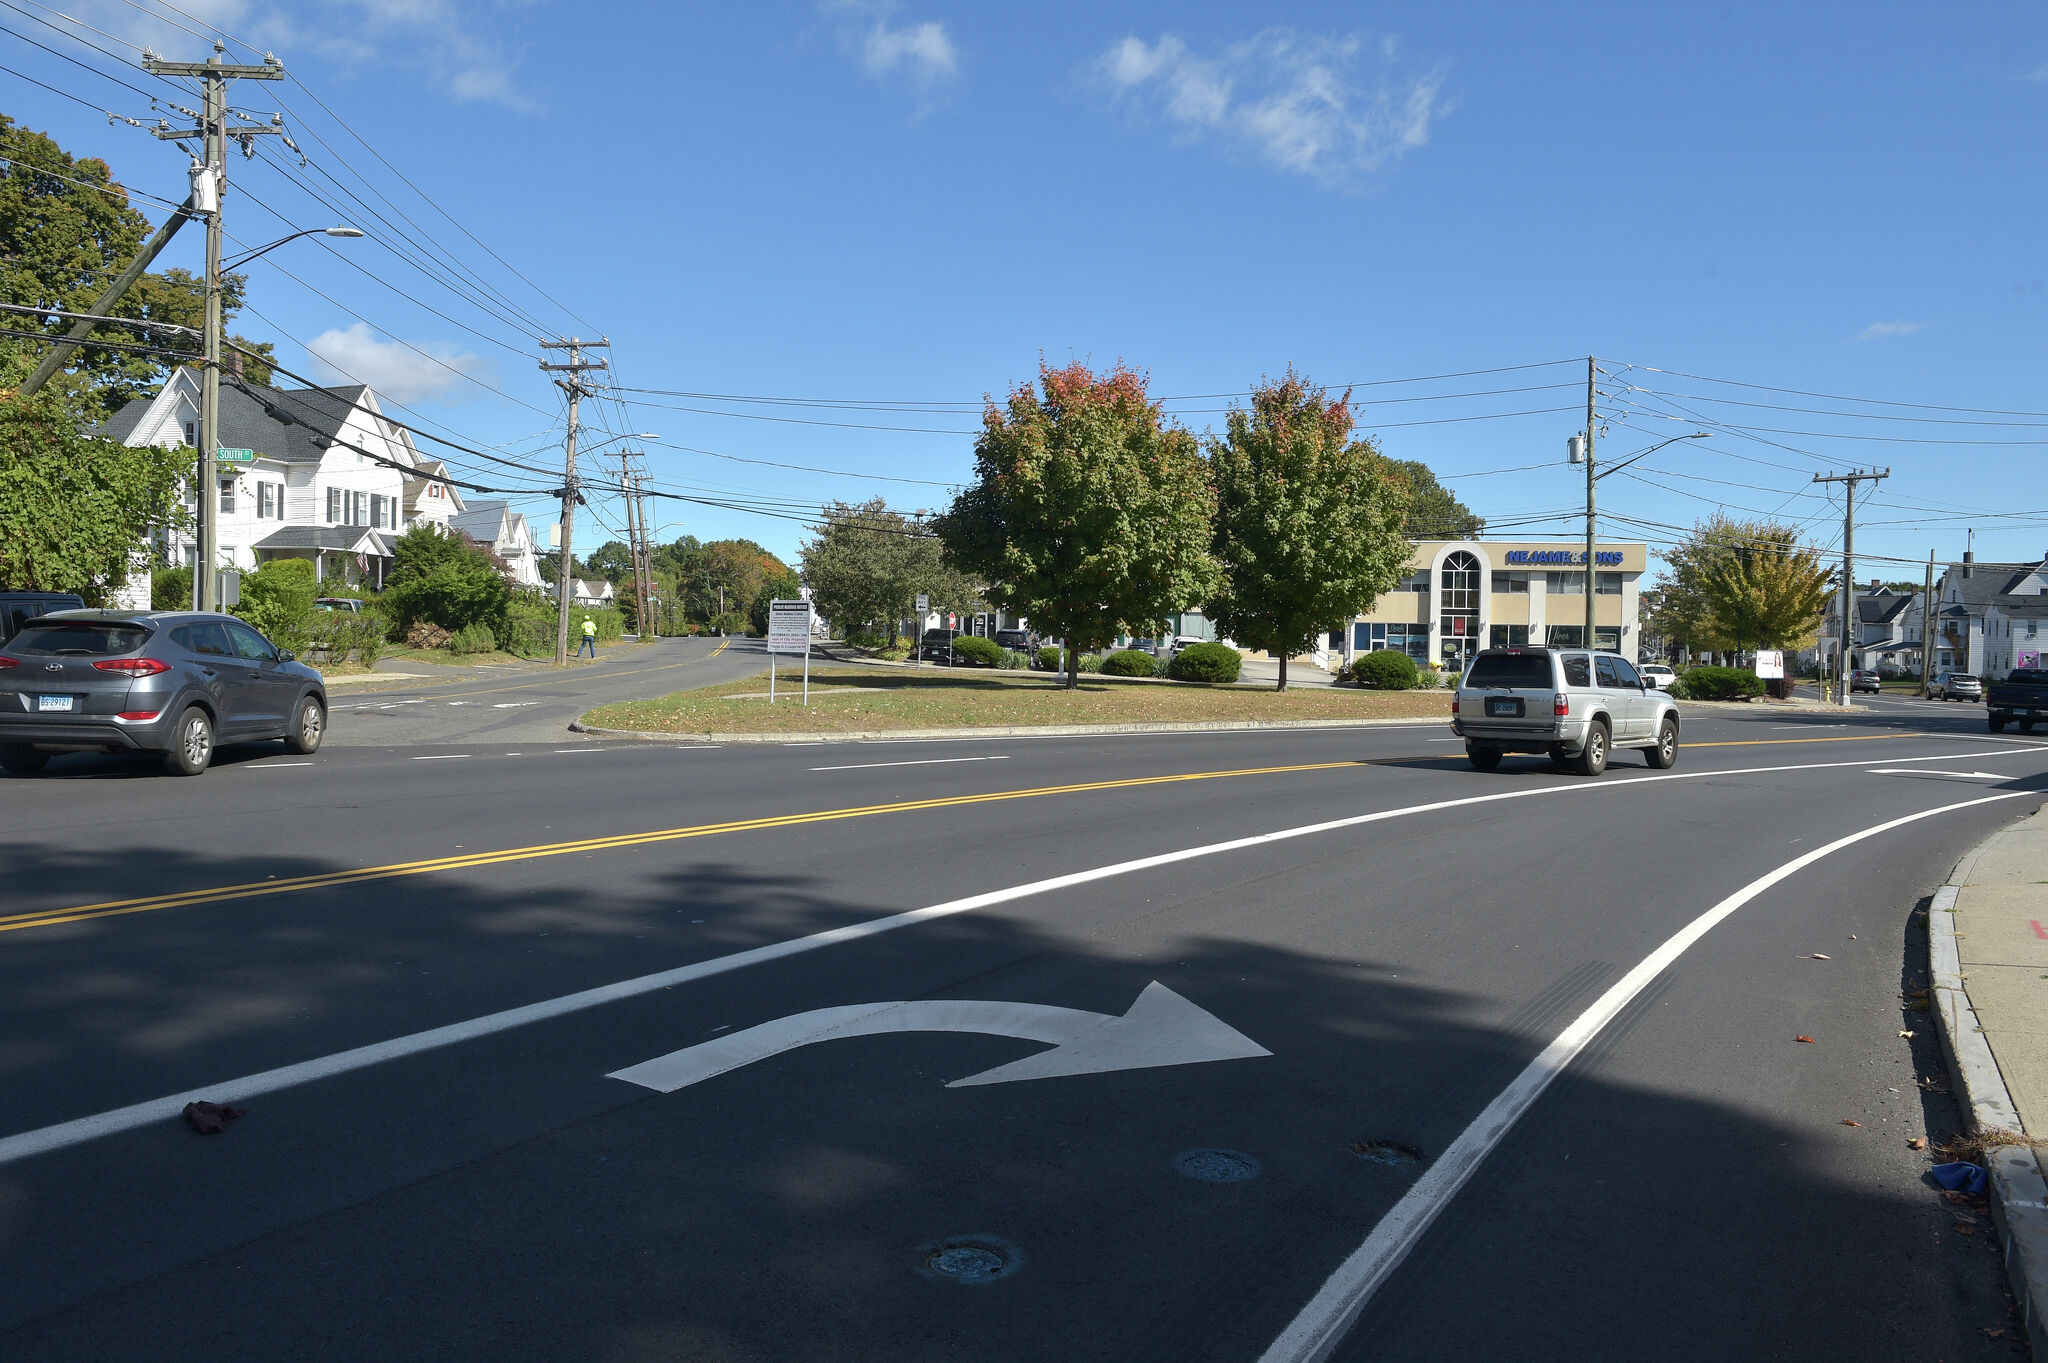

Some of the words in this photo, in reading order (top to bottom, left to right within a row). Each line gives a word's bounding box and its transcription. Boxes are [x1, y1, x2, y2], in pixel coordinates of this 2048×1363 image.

[220, 450, 242, 459] SOUTH
[1508, 550, 1569, 563] NEJAME
[1570, 551, 1582, 563] &
